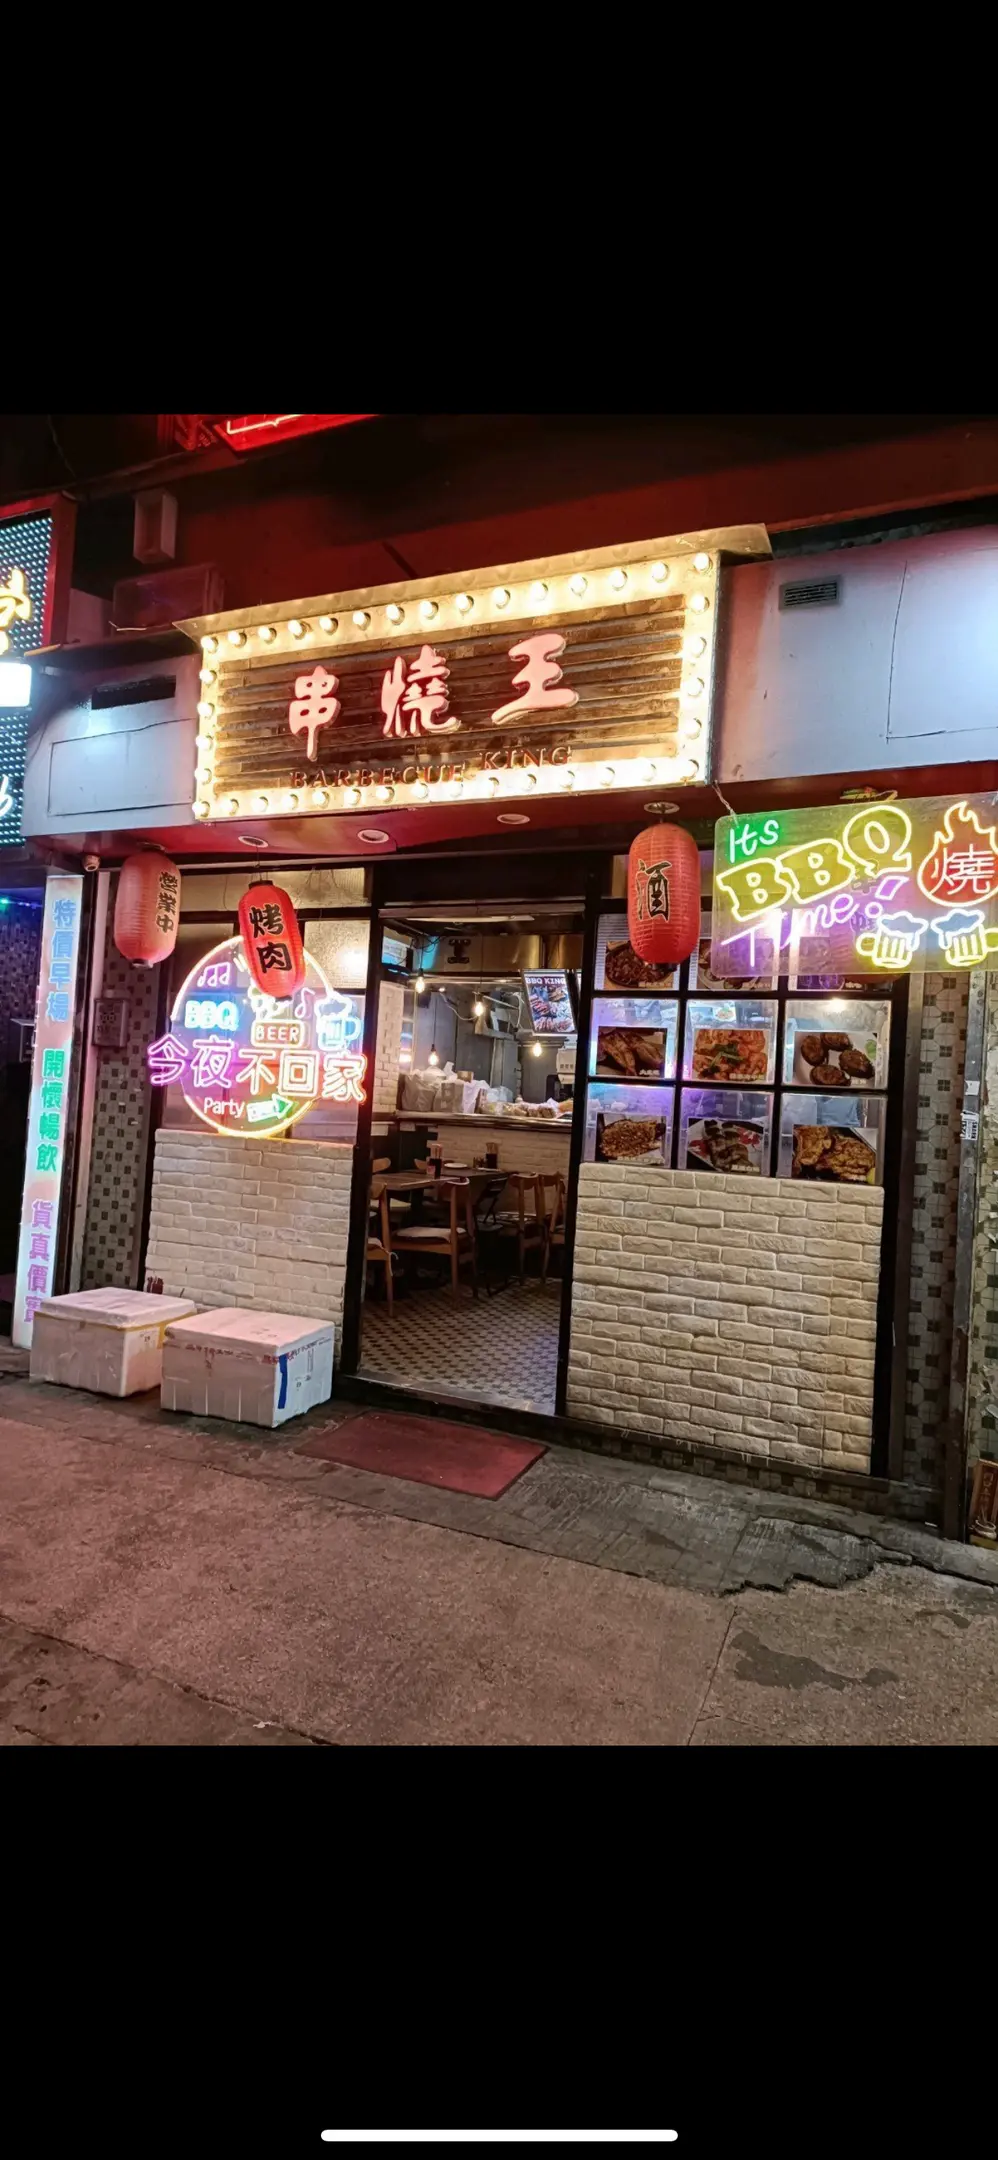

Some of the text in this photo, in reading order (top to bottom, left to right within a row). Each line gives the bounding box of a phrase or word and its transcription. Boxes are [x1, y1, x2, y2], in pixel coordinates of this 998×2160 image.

[289, 633, 579, 762] 串燒王
[290, 746, 573, 788] BARBECUE KING
[715, 804, 913, 923] BBQ
[728, 819, 780, 863] Its
[930, 843, 995, 895] 燒
[156, 871, 179, 934] 營業中
[636, 858, 671, 922] 酒
[249, 903, 293, 974] 烤肉
[526, 977, 566, 985] BBQ KING
[184, 1000, 239, 1031] BBQ
[255, 1026, 299, 1042] BEER
[148, 1034, 367, 1102] 今夜不回家
[36, 1049, 65, 1172] 開懷暢飲
[203, 1097, 245, 1118] Party
